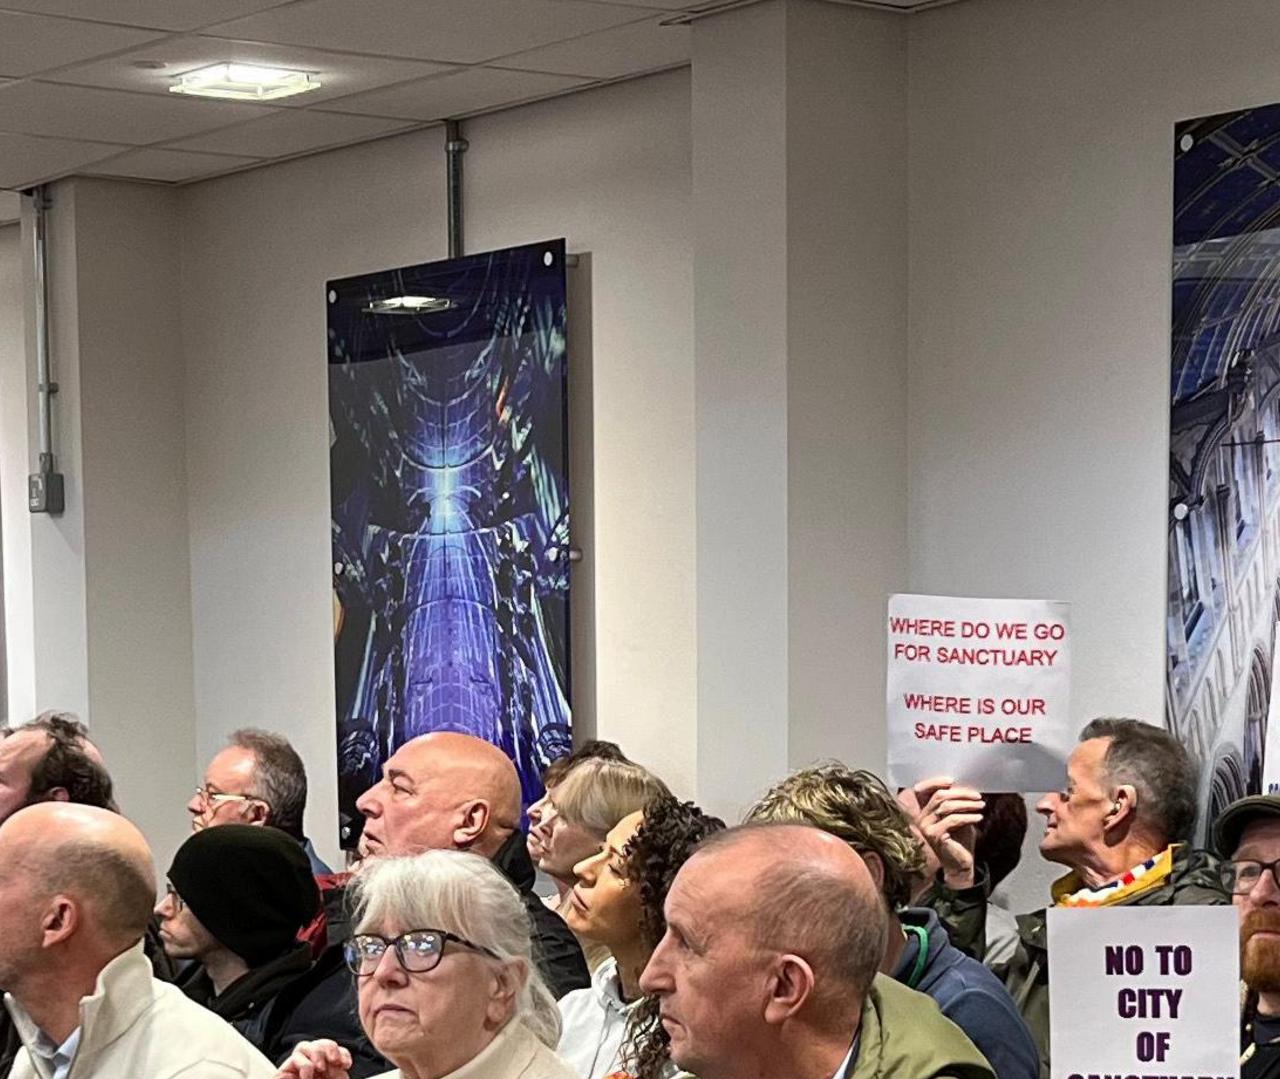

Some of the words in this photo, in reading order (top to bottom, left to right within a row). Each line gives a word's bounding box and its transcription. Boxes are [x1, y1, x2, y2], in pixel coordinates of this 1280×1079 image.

[890, 617, 955, 637] WHERE
[961, 622, 990, 639] DO
[996, 623, 1028, 640] WE
[1034, 624, 1065, 640] GO
[894, 644, 931, 662] FOR
[937, 647, 1058, 666] SANCTUARY
[904, 693, 971, 714] WHERE
[977, 699, 995, 715] IS
[1001, 699, 1046, 715] OUR
[914, 722, 962, 742] SAFE
[967, 727, 1033, 744] PLACE
[1105, 945, 1144, 976] NO
[1155, 945, 1193, 976] TO
[1117, 988, 1183, 1019] CITY
[1136, 1031, 1170, 1062] OF
